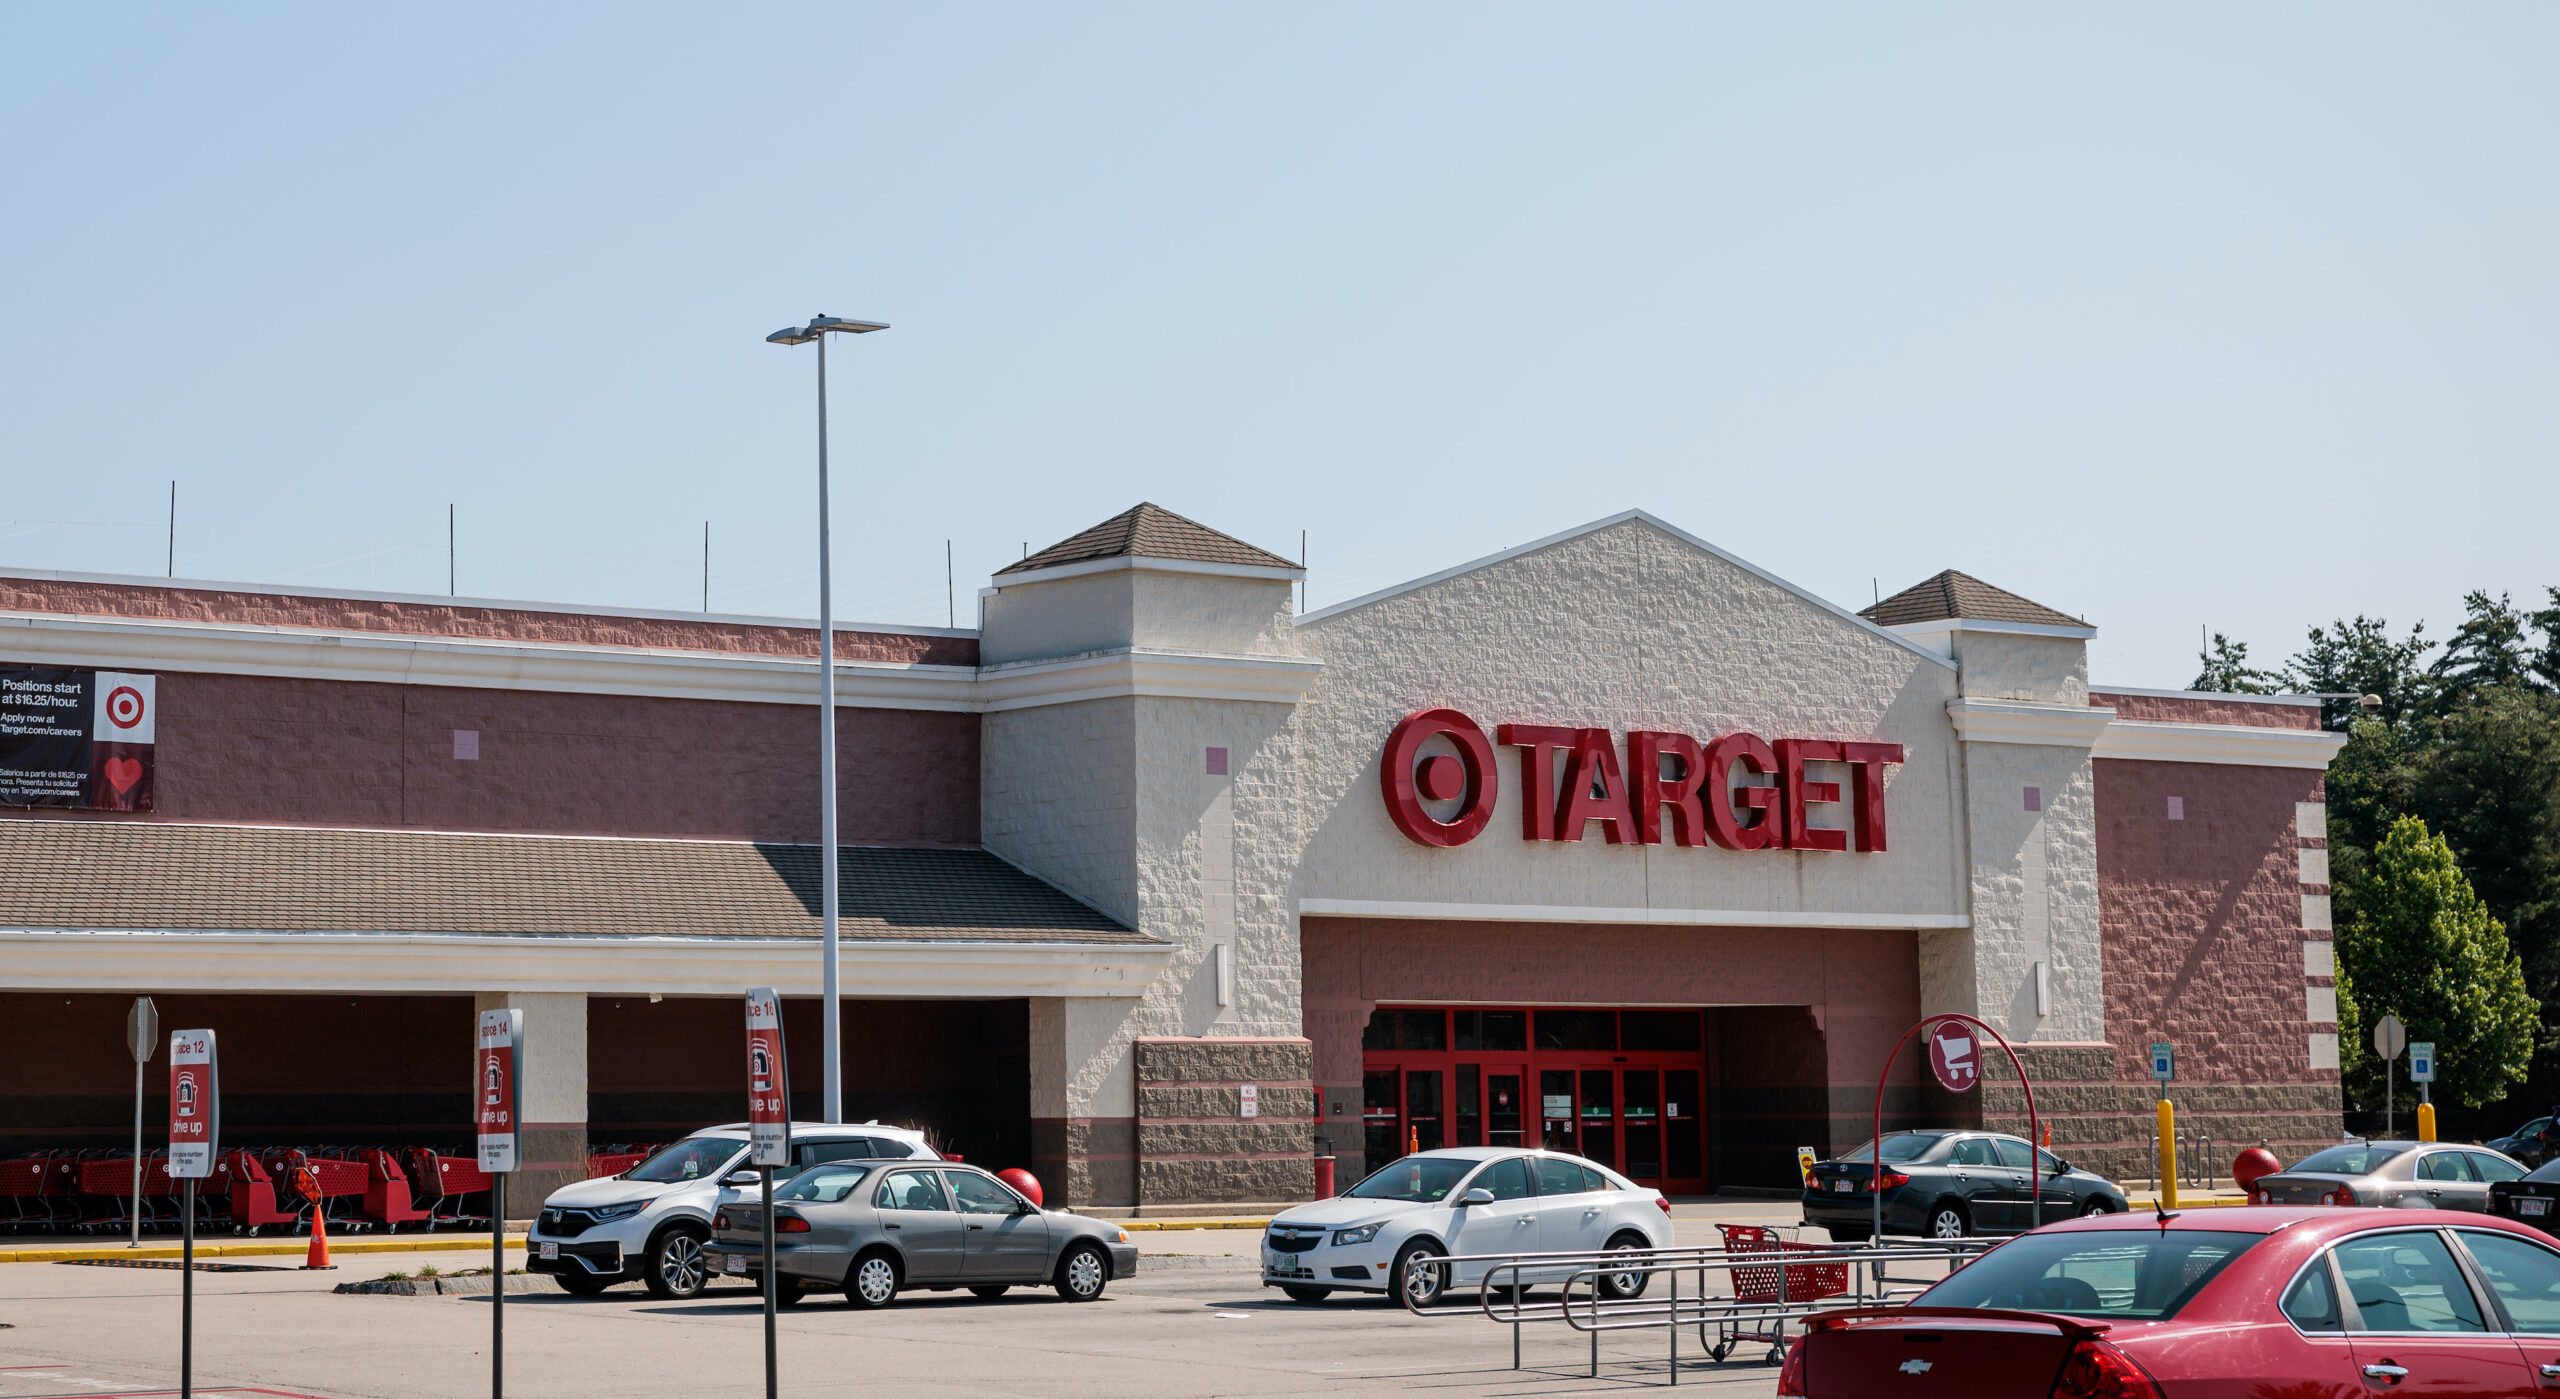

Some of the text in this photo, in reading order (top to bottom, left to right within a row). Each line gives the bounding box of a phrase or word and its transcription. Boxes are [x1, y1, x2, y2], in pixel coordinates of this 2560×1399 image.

[2, 679, 82, 694] Positions start
[1, 693, 78, 708] at $16.25/hour.
[0, 712, 55, 724] Apply now at
[0, 723, 82, 736] Target.com/careers
[0, 768, 24, 777] Salarios
[30, 770, 47, 778] partir
[48, 770, 57, 778] de
[77, 772, 88, 781] por
[16, 777, 44, 786] Presenta
[52, 780, 78, 788] solicitud
[1497, 722, 1904, 854] TARGET
[20, 786, 80, 797] Target.com/careers
[763, 1000, 774, 1016] 16
[481, 1020, 507, 1039] space 14
[173, 1039, 204, 1056] space 12
[767, 1098, 781, 1116] up
[481, 1107, 508, 1127] drive up
[173, 1118, 203, 1136] drive up
